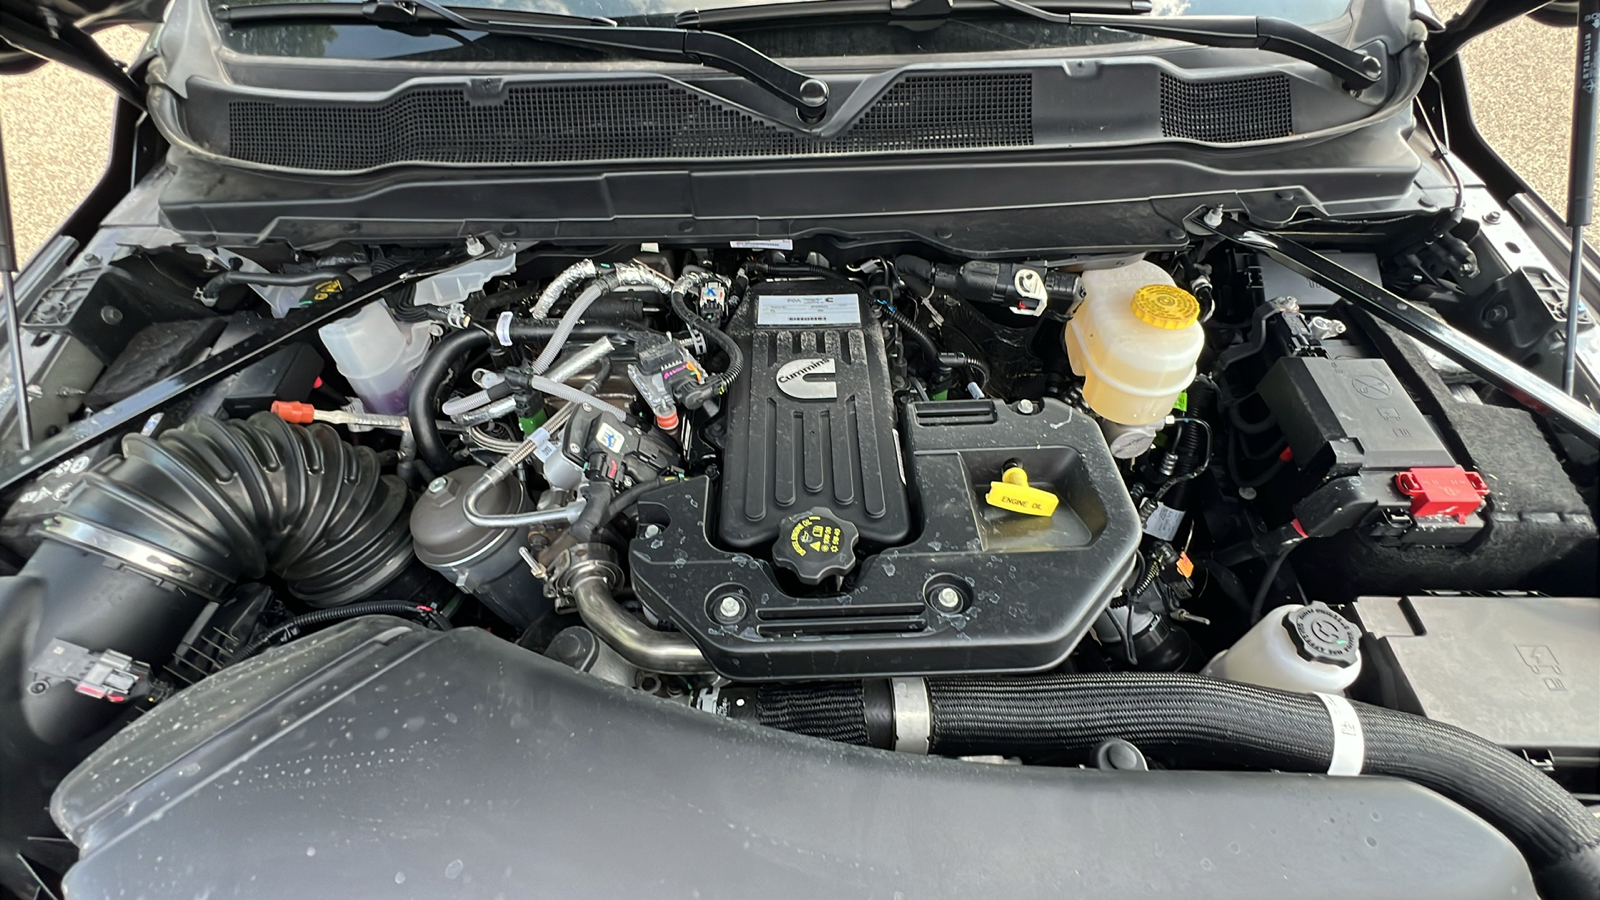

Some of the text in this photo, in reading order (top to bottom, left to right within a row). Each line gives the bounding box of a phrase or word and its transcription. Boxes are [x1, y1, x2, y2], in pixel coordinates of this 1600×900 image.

[1583, 33, 1591, 79] STABILUS
[777, 358, 830, 383] Cummins
[1002, 496, 1042, 510] ENGINE OIL
